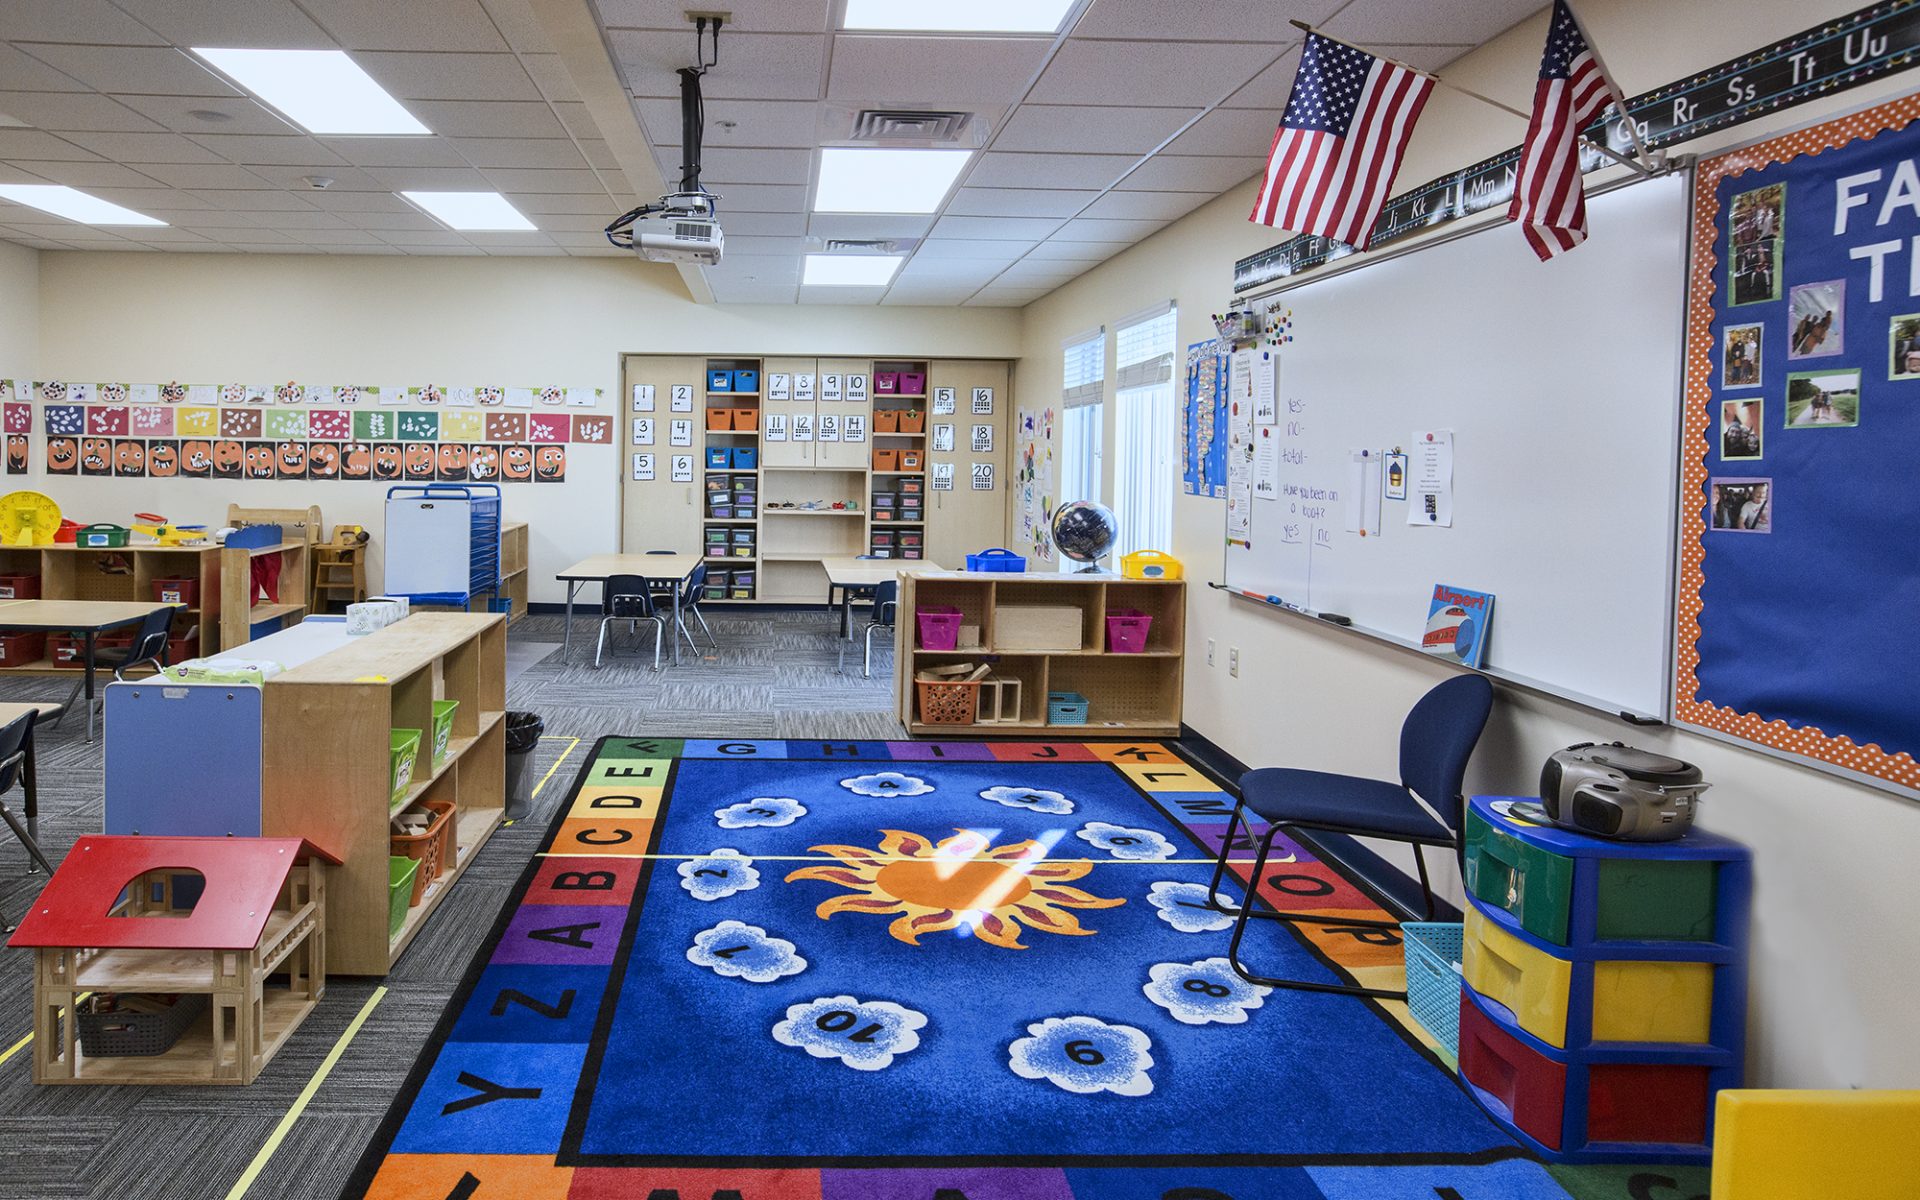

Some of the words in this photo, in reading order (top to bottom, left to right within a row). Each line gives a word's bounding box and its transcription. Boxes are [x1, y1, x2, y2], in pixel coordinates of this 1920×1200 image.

[1280, 251, 1290, 266] Dd
[1292, 247, 1300, 263] Ee
[1308, 239, 1320, 257] Ff
[1388, 210, 1398, 231] Jj
[1411, 198, 1426, 219] Kk
[1471, 176, 1495, 199] Mm
[1673, 97, 1698, 126] Rr
[1726, 77, 1756, 107] Ss
[1788, 51, 1816, 85] Tt
[1843, 27, 1888, 65] Uu
[775, 376, 784, 388] 7
[800, 376, 808, 388] 8
[828, 376, 836, 388] 9
[850, 376, 862, 388] 10
[677, 387, 686, 400] 2
[939, 389, 949, 401] 15
[976, 389, 988, 401] 16
[639, 420, 648, 432] 3
[676, 421, 686, 434] 4
[772, 416, 780, 428] 11
[798, 416, 808, 428] 12
[824, 416, 834, 428] 13
[849, 417, 859, 429] 14
[938, 426, 949, 438] 17
[977, 427, 987, 439] 18
[639, 456, 648, 468] 5
[678, 458, 687, 469] 6
[938, 465, 948, 477] 19
[974, 465, 992, 477] 20
[1310, 486, 1327, 500] been
[1329, 490, 1338, 501] on
[1302, 504, 1326, 519] boat?
[1317, 528, 1330, 543] no
[1433, 585, 1485, 611] Airport
[626, 740, 660, 754] F
[717, 743, 757, 755] G
[821, 744, 858, 756] H
[1032, 746, 1059, 758] J
[1114, 747, 1164, 762] K
[604, 766, 653, 778] E
[1142, 772, 1188, 783] L
[590, 795, 642, 809] D
[1174, 800, 1236, 816] M
[576, 828, 632, 845] C
[694, 868, 728, 879] 2
[551, 870, 617, 891] B
[1267, 874, 1335, 897] O
[527, 921, 601, 949] A
[1321, 928, 1403, 947] P
[1183, 979, 1231, 998] 8
[489, 987, 578, 1020] Z
[814, 1009, 888, 1045] 10
[440, 1070, 543, 1118] Y
